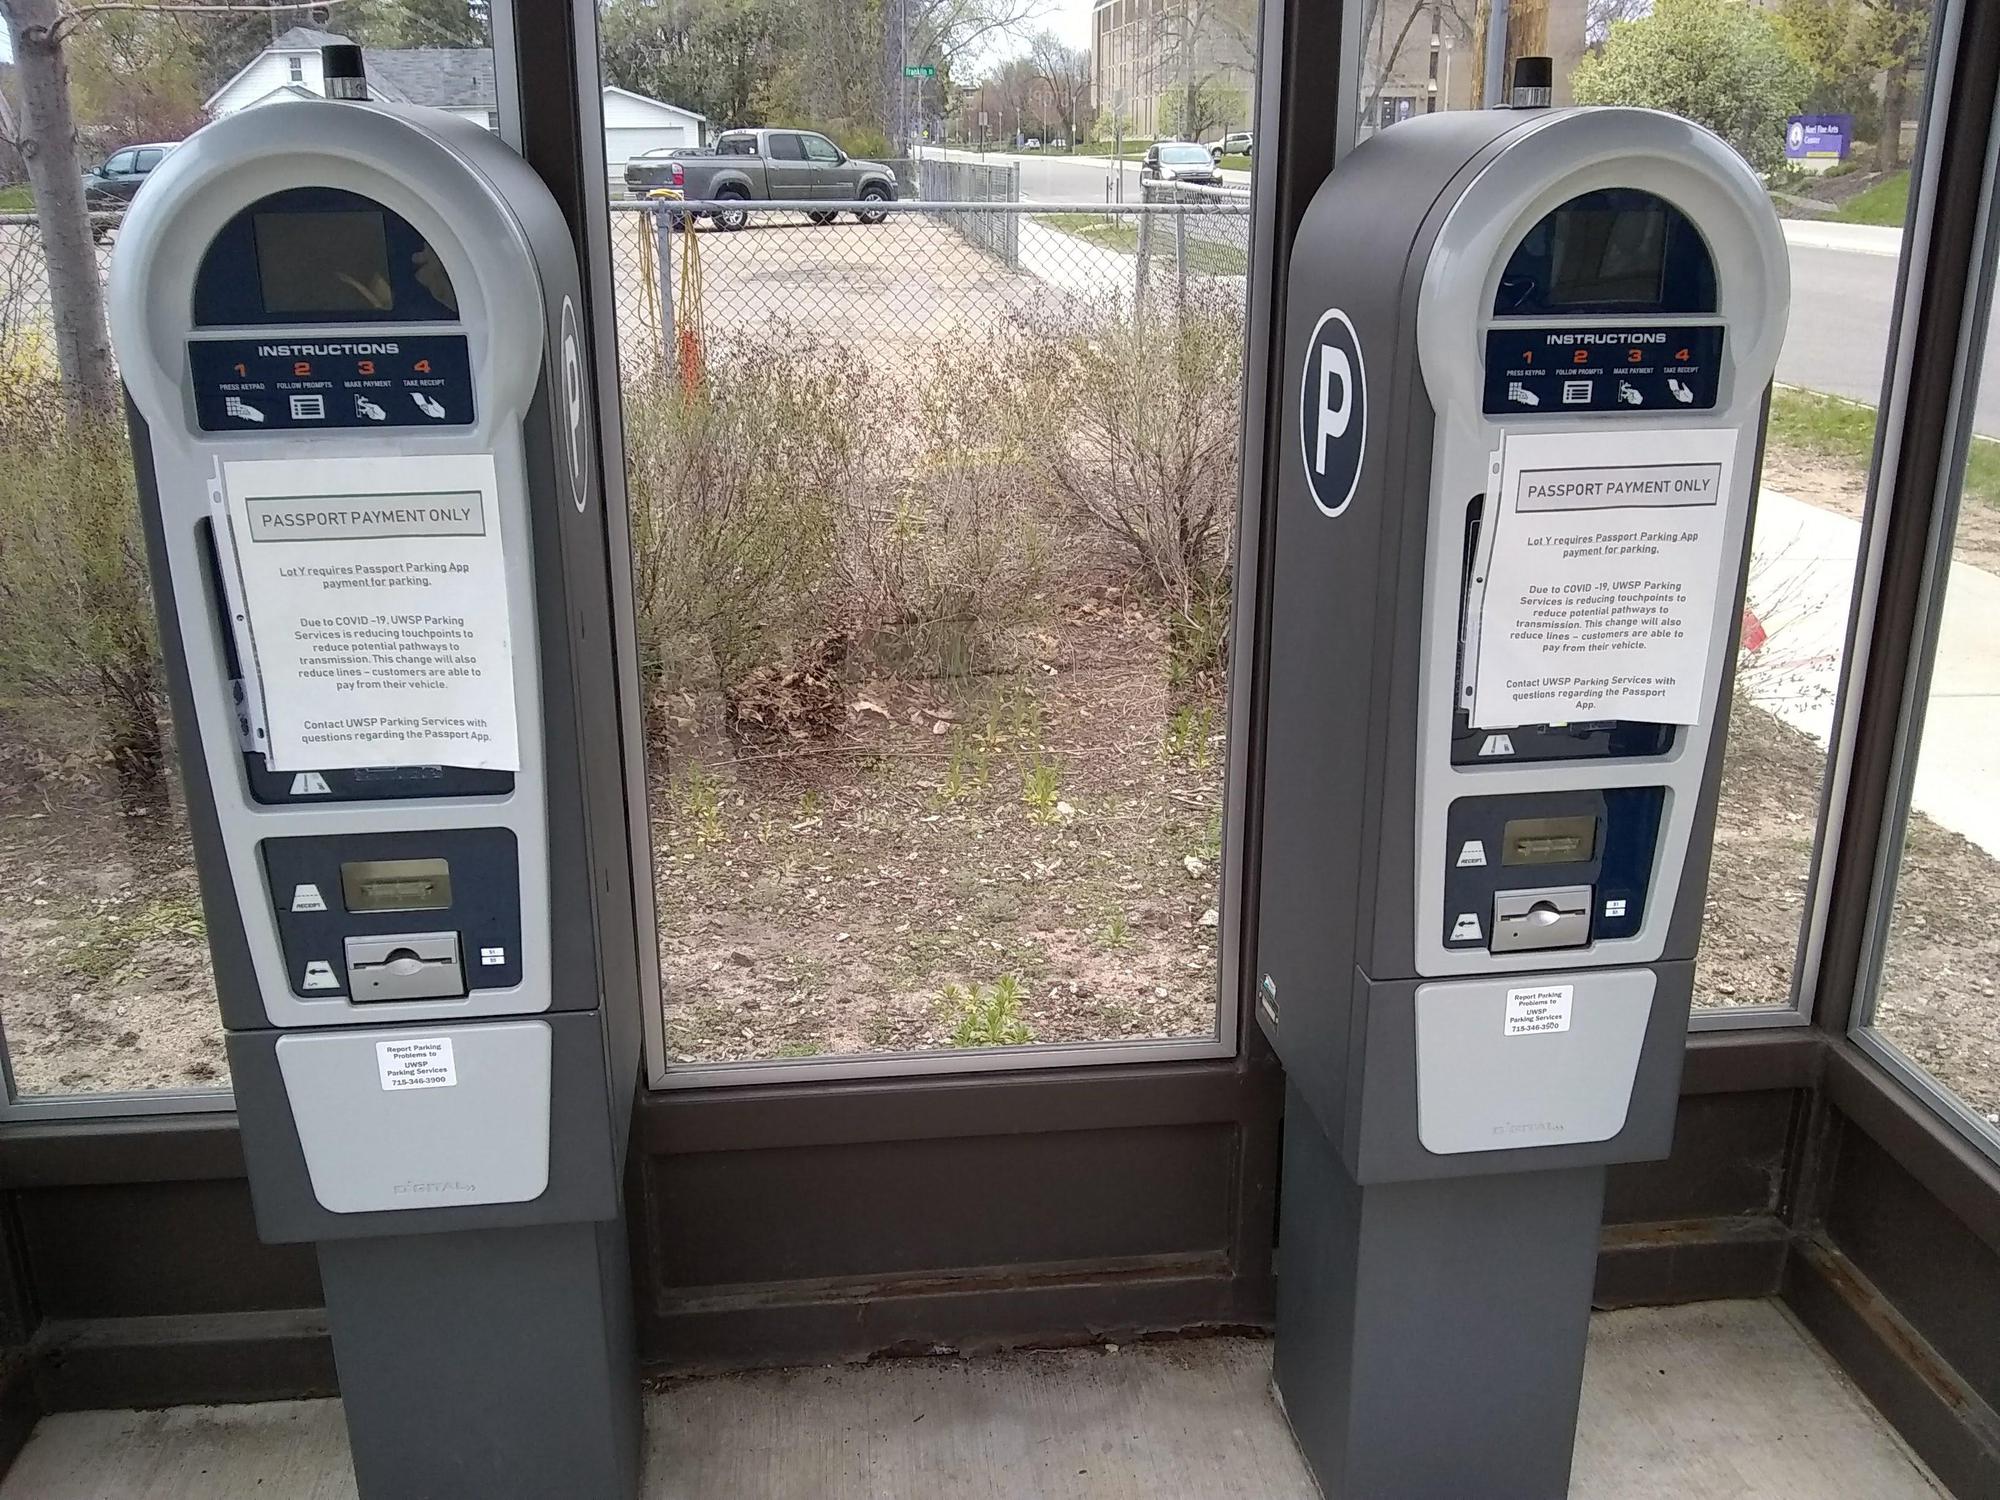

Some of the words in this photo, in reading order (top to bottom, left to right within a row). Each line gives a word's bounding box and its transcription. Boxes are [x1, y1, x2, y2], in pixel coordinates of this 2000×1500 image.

[906, 68, 927, 76] Franklin
[1817, 125, 1827, 133] Fine
[1828, 125, 1838, 133] Arts
[1547, 334, 1666, 345] INSTRUCTIONS
[258, 344, 399, 357] INSTRUCTIONS
[1523, 351, 1532, 363] 1
[1574, 350, 1588, 363] 2
[1628, 350, 1642, 362] 3
[1675, 349, 1690, 361] 4
[235, 364, 246, 376] 1
[294, 362, 311, 376] 2
[358, 361, 374, 374] 3
[415, 360, 431, 373] 4
[565, 334, 580, 478] P
[1316, 344, 1352, 475] P
[1528, 483, 1603, 498] PASSPORT
[1606, 481, 1671, 494] PAYMENT
[1675, 479, 1711, 492] ONLY
[262, 512, 347, 527] PASSPORT
[351, 510, 425, 524] PAYMENT
[430, 509, 470, 521] ONLY
[1528, 537, 1545, 546] Lot
[1546, 537, 1552, 545] Y
[1554, 535, 1593, 546] requires
[1596, 533, 1637, 544] Passport
[1640, 532, 1678, 543] Parking
[1680, 533, 1698, 542] App
[1563, 547, 1602, 558] payment
[1620, 545, 1659, 555] parking.
[280, 568, 298, 576] Lot
[298, 567, 305, 576] Y
[307, 566, 353, 577] requires
[355, 564, 404, 574] Passport
[406, 563, 447, 573] Parking
[449, 563, 469, 573] App
[323, 579, 369, 589] payment
[370, 577, 386, 587] for
[389, 577, 431, 587] parking.
[1564, 584, 1591, 593] COVID
[1644, 582, 1681, 592] Parking
[1520, 597, 1562, 605] Services
[1565, 597, 1573, 605] is
[1576, 595, 1615, 604] reducing
[1618, 594, 1673, 603] touchpoints
[1533, 609, 1567, 617] reduce
[1570, 607, 1608, 618] potential
[1611, 607, 1656, 616] pathways
[300, 618, 321, 627] Due
[336, 617, 368, 625] COVID
[424, 616, 464, 627] Parking
[1517, 620, 1581, 628] transmission.
[1585, 619, 1602, 628] This
[1605, 619, 1637, 627] change
[1661, 618, 1681, 626] also
[295, 631, 340, 640] Services
[343, 630, 352, 638] is
[354, 630, 399, 639] reducing
[402, 629, 461, 640] touchpoints
[463, 630, 473, 638] to
[1547, 632, 1569, 640] lines
[1582, 631, 1628, 640] customers
[313, 643, 349, 651] reduce
[352, 643, 397, 652] potential
[399, 643, 447, 652] pathways
[1543, 645, 1560, 653] pay
[1563, 644, 1585, 652] from
[1589, 642, 1609, 651] their
[300, 655, 371, 664] transmission.
[372, 655, 394, 663] This
[396, 655, 432, 665] change
[434, 655, 453, 663] will
[455, 655, 476, 663] also
[299, 669, 334, 677] reduce
[336, 668, 361, 676] lines
[372, 668, 426, 676] customers
[448, 668, 469, 676] able
[471, 668, 481, 676] to
[336, 683, 354, 691] pay
[357, 680, 381, 688] from
[383, 680, 406, 688] their
[408, 680, 448, 688] vehicle.
[1507, 679, 1539, 688] Contact
[1543, 678, 1571, 686] UWSP
[1574, 678, 1609, 687] Parking
[1655, 677, 1675, 685] with
[1513, 691, 1555, 702] questions
[1558, 690, 1603, 699] regarding
[1622, 689, 1665, 698] Passport
[1576, 701, 1595, 710] App.
[304, 720, 344, 729] Contact
[346, 719, 377, 727] UWSP
[380, 719, 419, 731] Parking
[421, 718, 465, 726] Services
[466, 719, 487, 727] with
[302, 733, 352, 744] questions
[355, 732, 404, 741] regarding
[425, 731, 469, 739] Passport
[471, 732, 491, 742] App.
[392, 1077, 446, 1085] 715-346-3900
